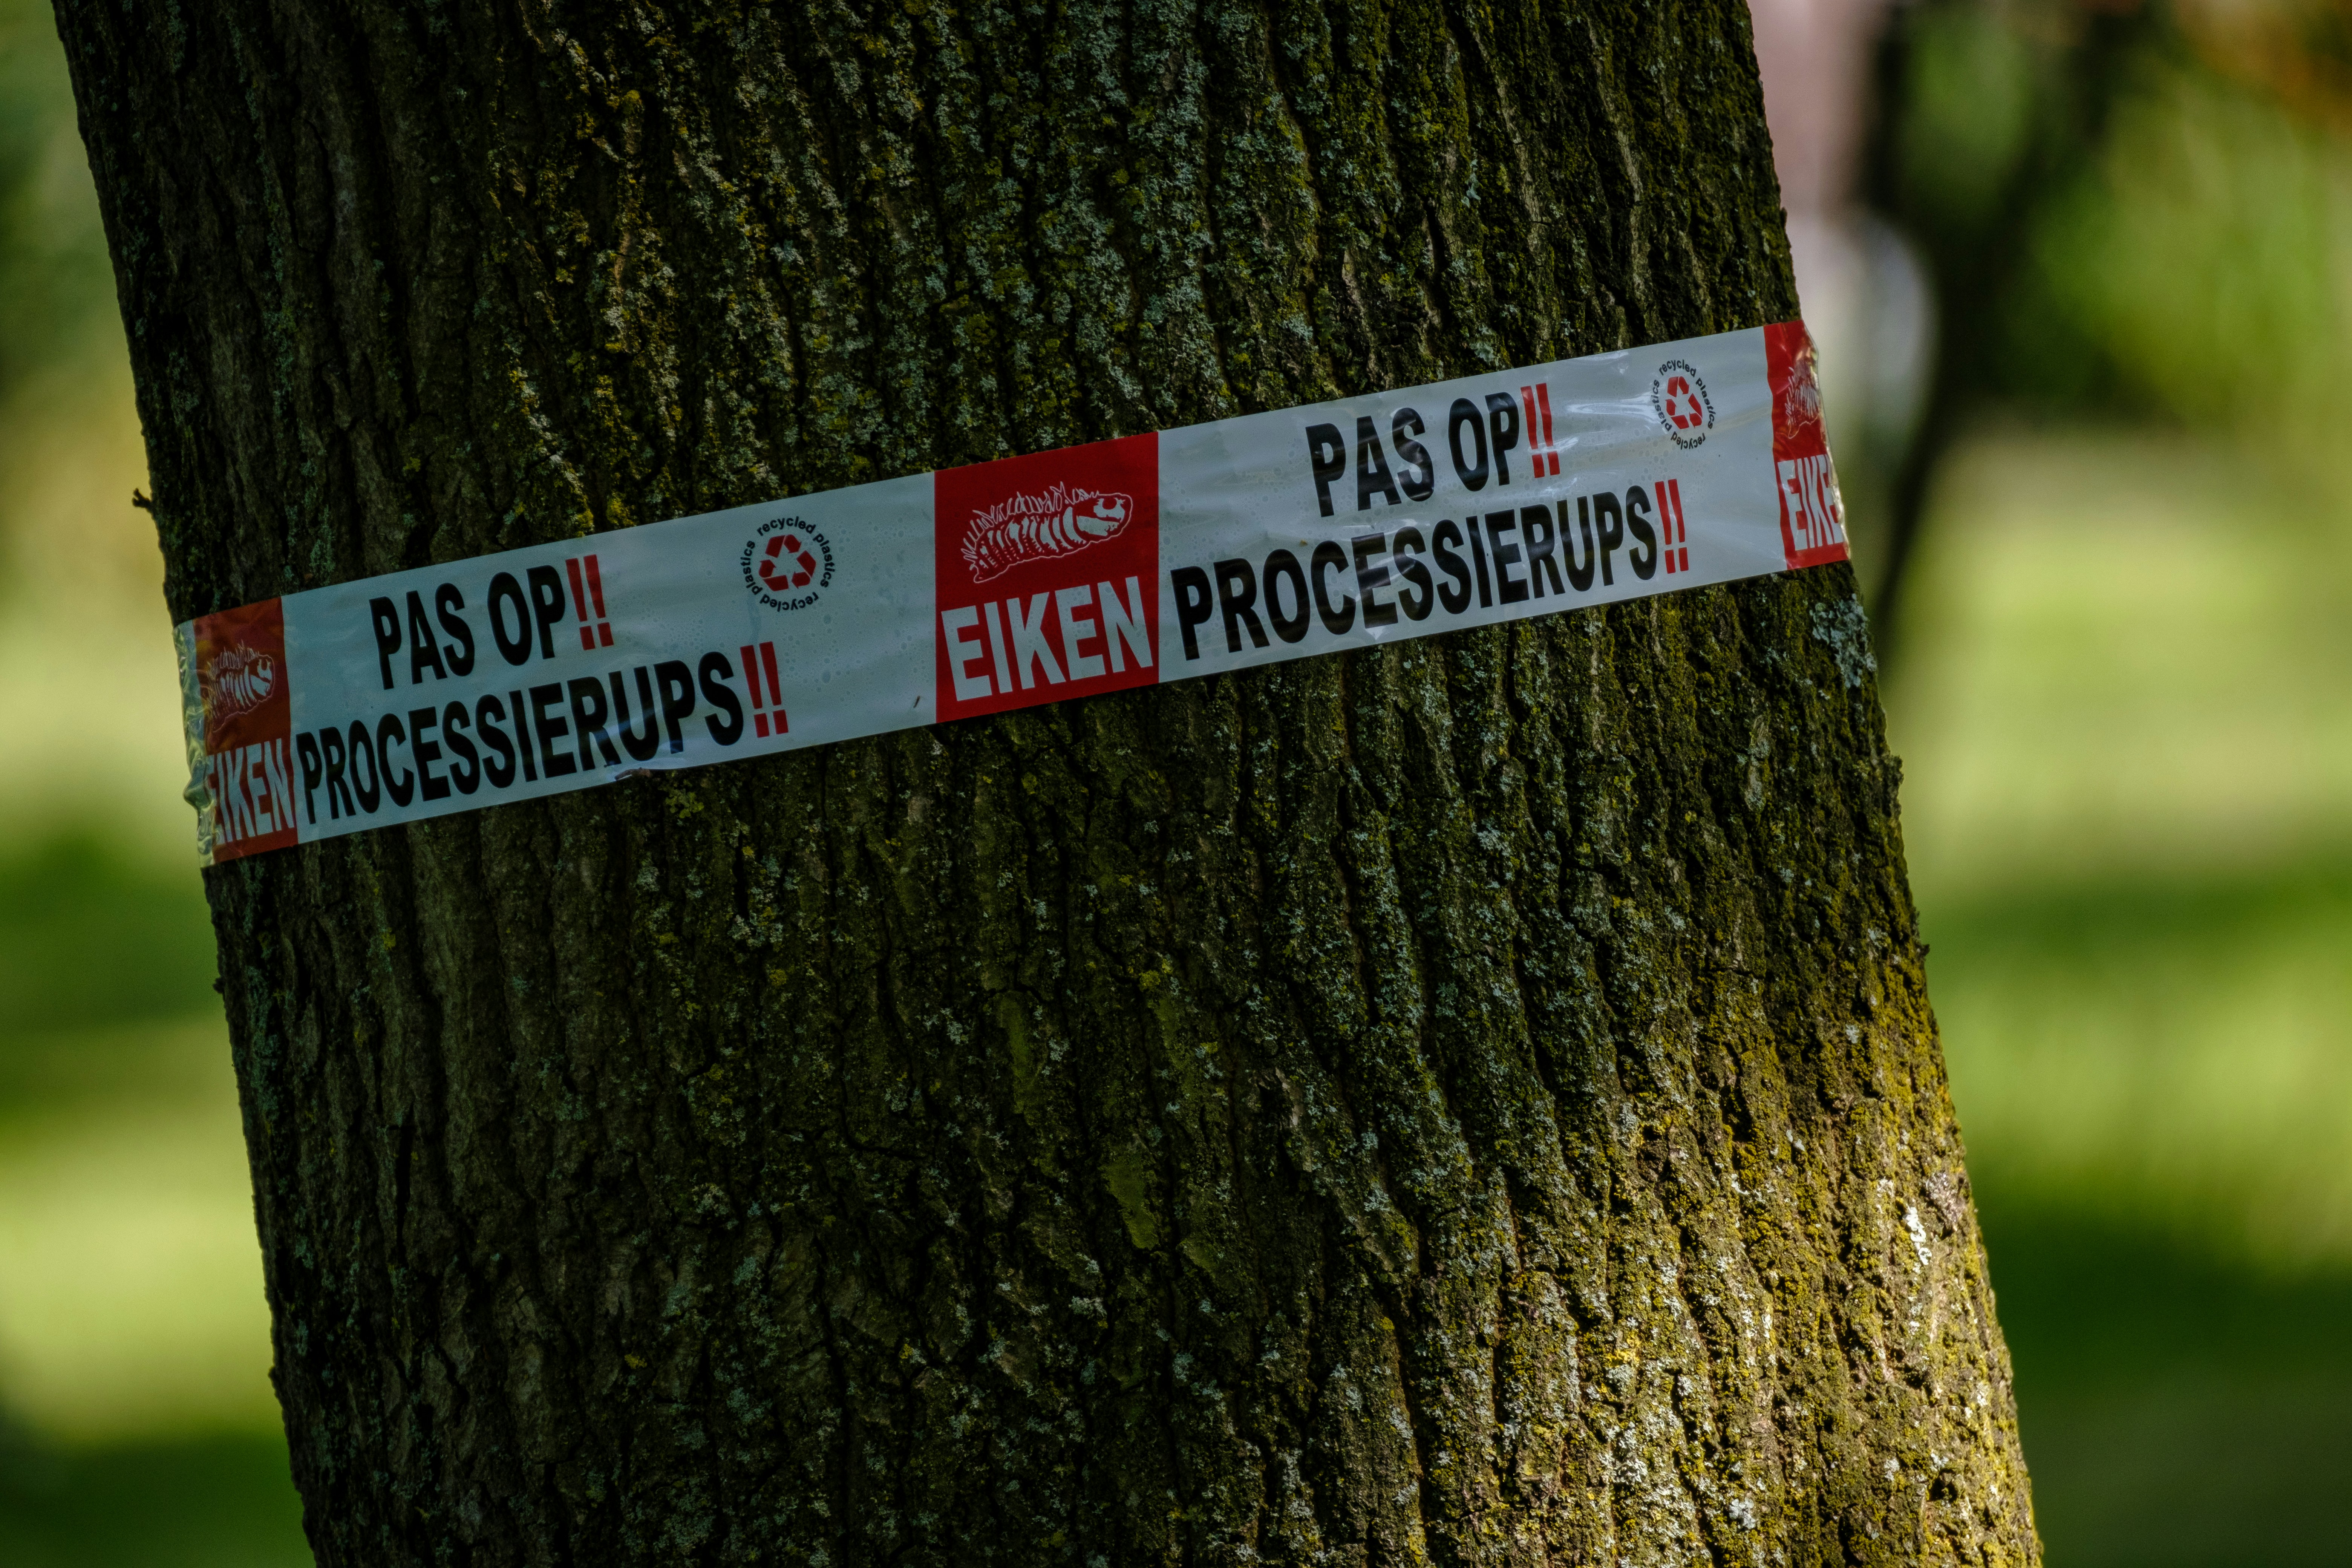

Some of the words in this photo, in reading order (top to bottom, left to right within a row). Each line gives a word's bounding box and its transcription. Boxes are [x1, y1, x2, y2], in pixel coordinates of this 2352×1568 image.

[1651, 379, 1672, 432] plastics
[1659, 359, 1696, 377] recycled
[1695, 377, 1716, 429] plastics
[1305, 407, 1434, 517] PAS
[1448, 383, 1560, 492] OP!!
[1671, 431, 1706, 450] recycled
[740, 541, 763, 595] plastics
[757, 516, 816, 536] recycled
[813, 533, 835, 588] plastics
[369, 583, 475, 690] PAS
[487, 554, 614, 666] OP!!
[760, 592, 819, 612] recycled
[941, 576, 1153, 701] EIKEN
[1170, 478, 1689, 660] PROCESSIERUPS!!
[296, 641, 789, 824] PROCESSIERUPS!!
